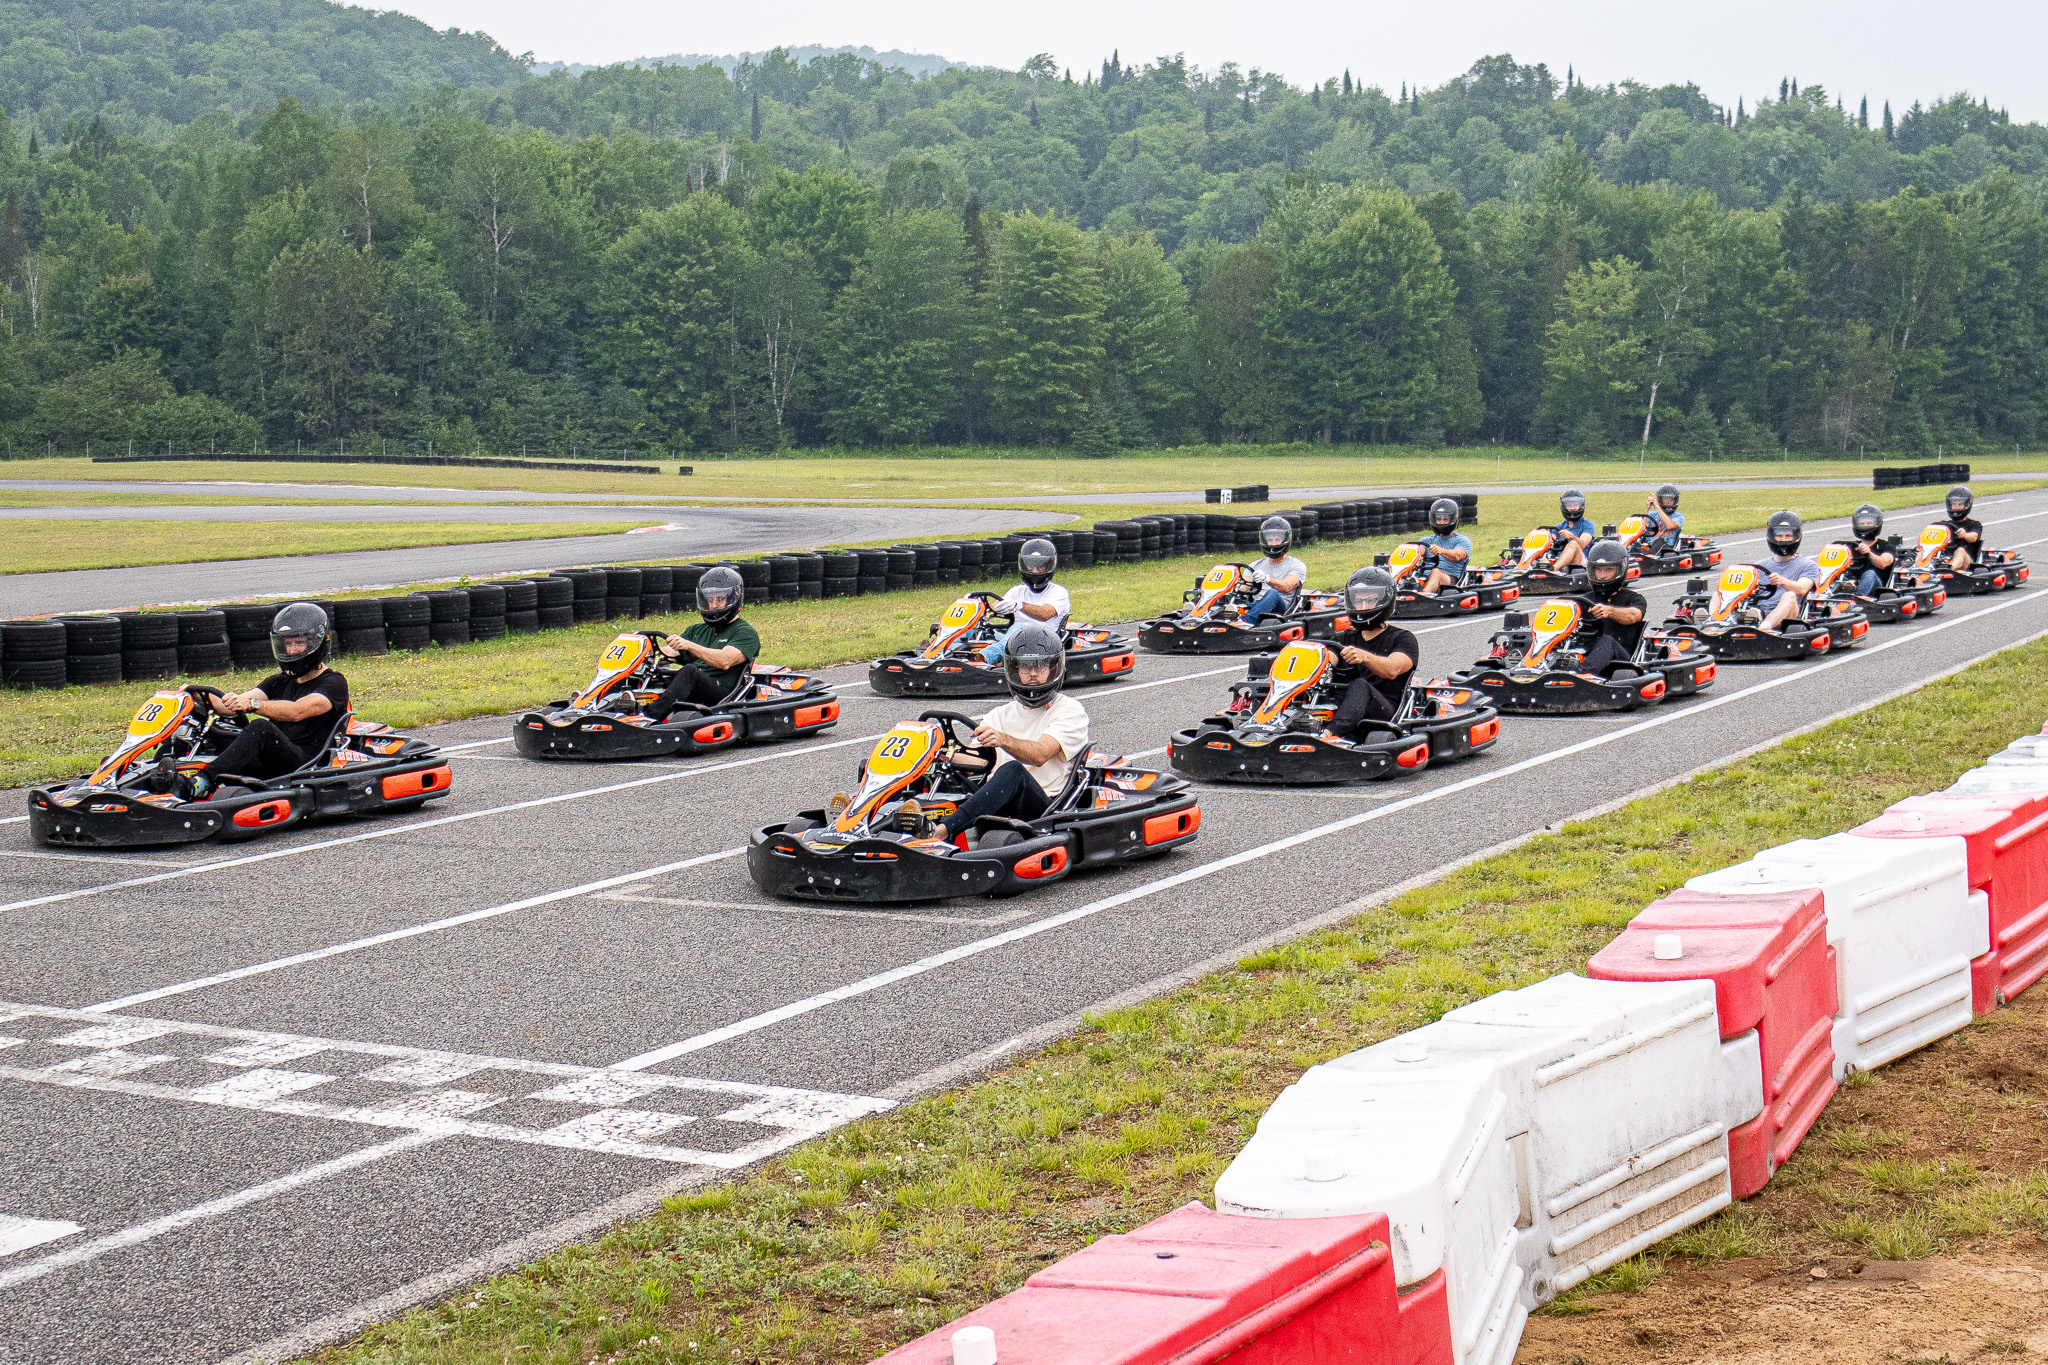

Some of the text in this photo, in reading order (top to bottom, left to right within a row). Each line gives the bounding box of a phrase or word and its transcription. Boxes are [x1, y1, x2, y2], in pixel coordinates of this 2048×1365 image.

[1825, 551, 1838, 560] 19
[1208, 572, 1224, 582] 29
[1728, 573, 1743, 584] 16
[950, 606, 967, 618] 15
[1546, 611, 1558, 625] 2
[605, 645, 627, 660] 24
[1288, 655, 1297, 673] 1
[137, 703, 164, 722] 28
[879, 736, 910, 758] 23
